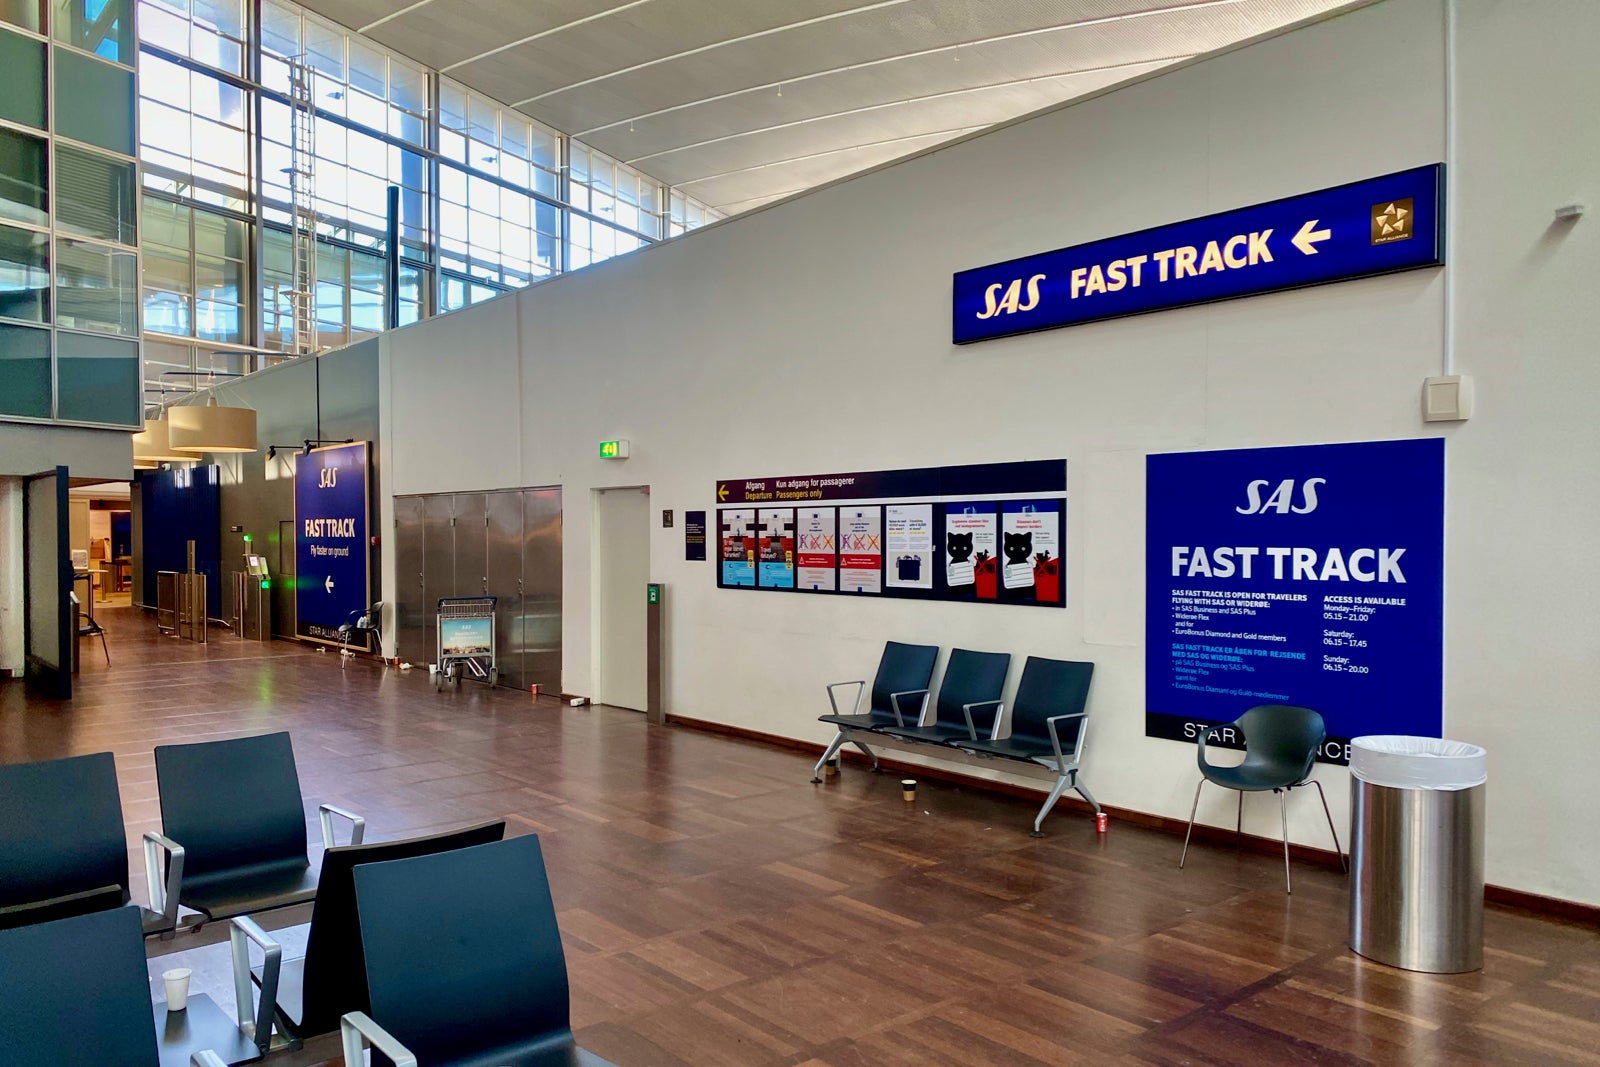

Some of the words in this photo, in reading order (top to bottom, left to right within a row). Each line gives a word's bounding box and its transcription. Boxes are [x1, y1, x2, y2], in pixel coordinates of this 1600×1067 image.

[976, 274, 1046, 319] SAS
[1071, 255, 1146, 299] FAST
[1153, 228, 1274, 282] TRACK
[318, 467, 338, 488] SAS
[745, 482, 765, 491] Afgang
[776, 480, 787, 488] Kun
[788, 480, 809, 490] adgang
[810, 478, 819, 487] for
[820, 477, 855, 488] passagerer
[745, 491, 772, 500] Departure
[776, 490, 808, 500] Passengers
[809, 489, 822, 499] only
[1236, 477, 1326, 515] SAS
[305, 519, 325, 537] FAST
[326, 518, 355, 538] TRACK
[334, 545, 349, 558] ground
[1171, 547, 1259, 578] FAST
[1267, 547, 1407, 583] TRACK
[1202, 590, 1223, 598] TRACK
[1252, 592, 1266, 600] FOR
[1267, 593, 1307, 601] TRAVELERS
[1323, 595, 1353, 603] ACCESS
[1354, 596, 1362, 604] IS
[1363, 597, 1406, 606] AVAILABLE
[1243, 608, 1256, 616] Plus
[1323, 612, 1342, 620] 05.15
[1348, 613, 1369, 621] 21.00
[309, 625, 321, 635] STAR
[1175, 628, 1205, 636] EuroBonus
[1205, 630, 1231, 638] Diamond
[1258, 634, 1287, 642] members
[1323, 629, 1354, 639] Saturday:
[1323, 638, 1342, 646] 06.15
[1202, 645, 1223, 653] TRACK
[1269, 650, 1306, 660] REJSENDE
[1195, 660, 1219, 668] Business
[1323, 655, 1350, 664] Sunday:
[1323, 663, 1342, 671] 06.15
[1348, 665, 1369, 674] 20.00
